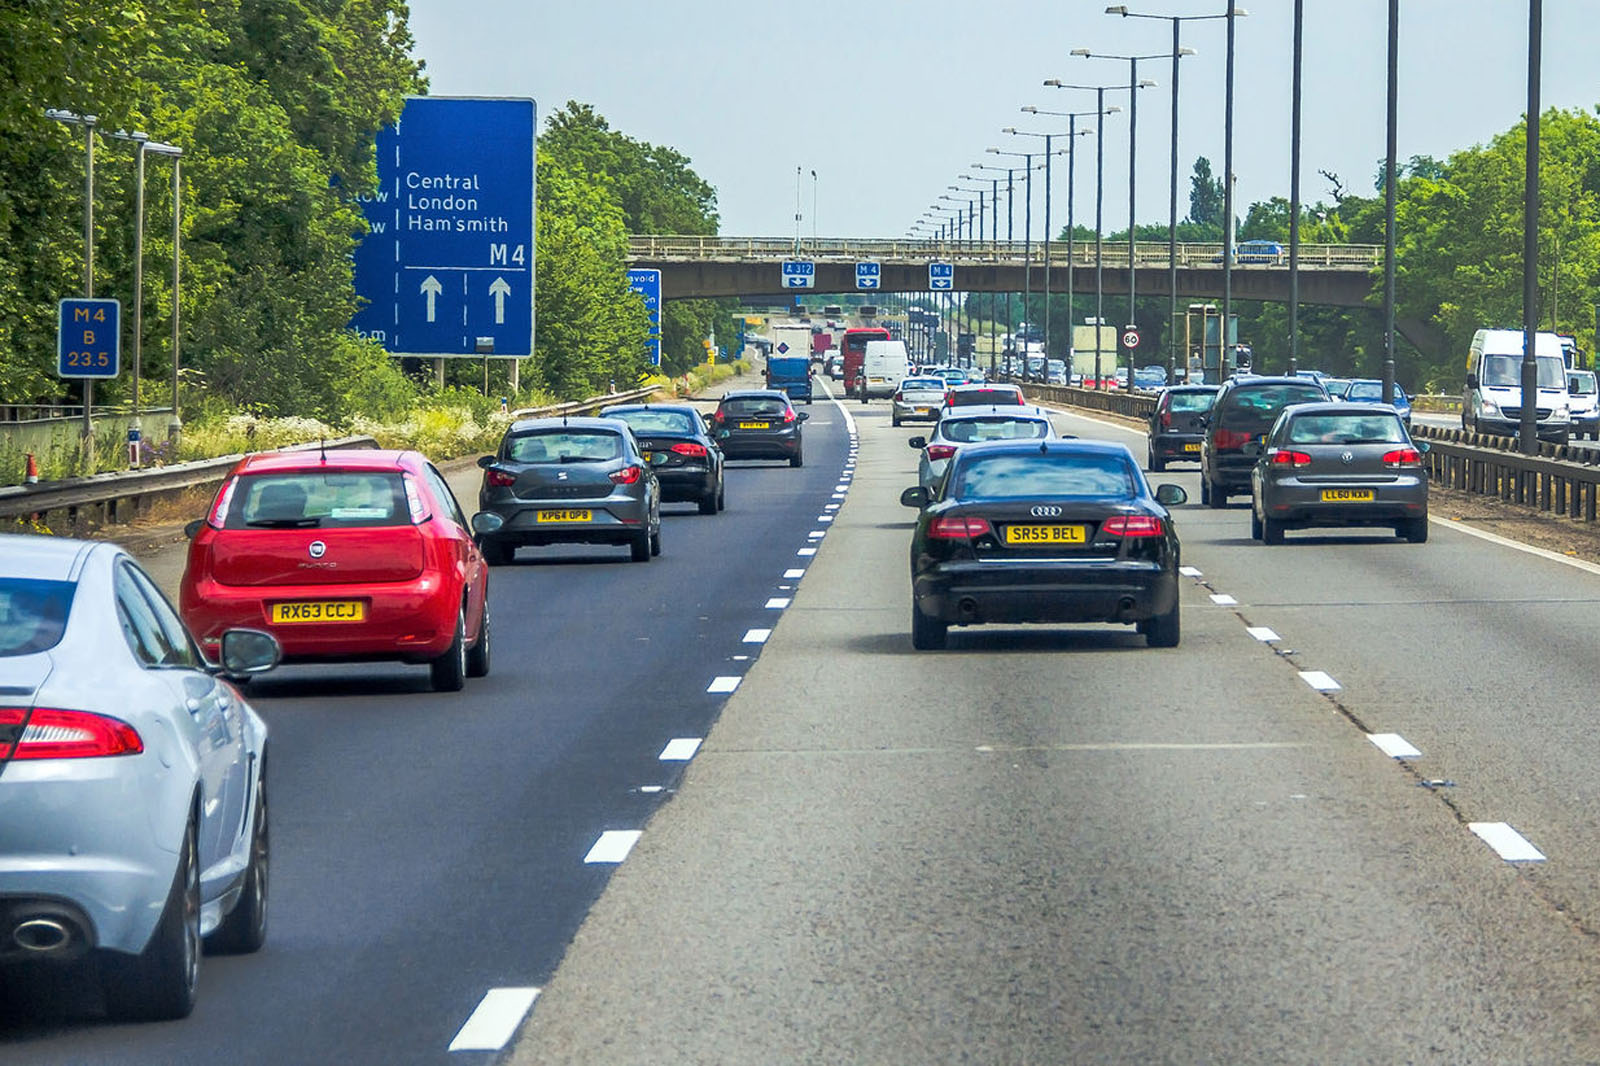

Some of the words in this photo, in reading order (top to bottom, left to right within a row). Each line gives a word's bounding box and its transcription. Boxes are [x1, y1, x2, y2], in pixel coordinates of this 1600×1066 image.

[406, 172, 480, 190] Central
[408, 194, 478, 210] London
[83, 330, 96, 345] B
[1125, 335, 1137, 344] 60
[67, 351, 110, 367] 23.5
[1013, 527, 1049, 540] SR55
[1052, 527, 1078, 540] BEL
[280, 604, 321, 619] RX63
[325, 604, 356, 618] CCJ
